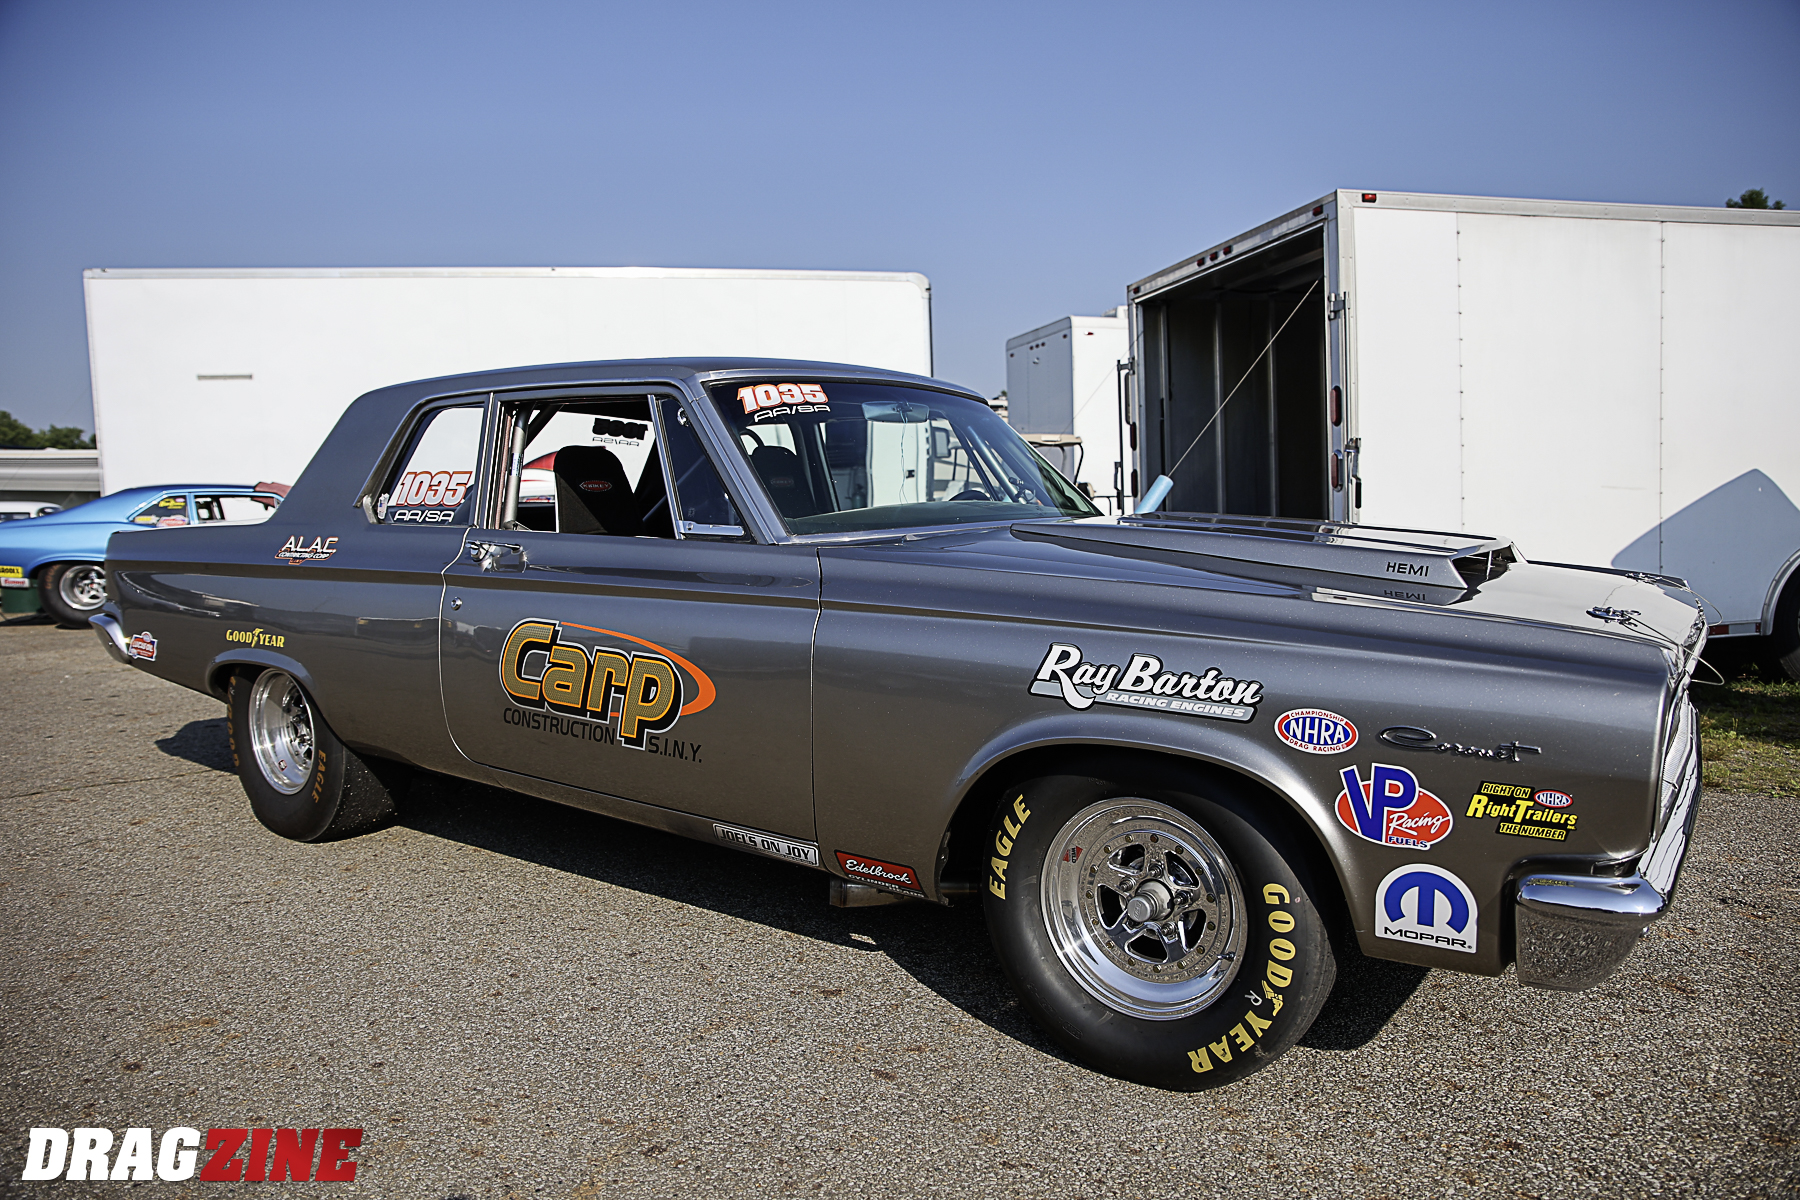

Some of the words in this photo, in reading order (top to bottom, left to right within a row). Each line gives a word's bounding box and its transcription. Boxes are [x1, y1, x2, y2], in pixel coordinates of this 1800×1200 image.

[737, 383, 829, 414] 1035
[753, 404, 831, 423] AA/SA
[396, 470, 474, 508] 1035
[393, 509, 455, 523] AA/SA
[1386, 561, 1429, 577] HEMI
[225, 627, 285, 648] GOODYEAR
[500, 618, 684, 750] Carp
[1035, 643, 1121, 710] Ray
[1117, 655, 1264, 704] Barton
[1105, 692, 1167, 709] RACING
[1168, 700, 1246, 718] ENGINES
[1290, 710, 1345, 722] CHAMPIONSHIP
[503, 707, 616, 746] CONSTRUCTION
[648, 735, 703, 764] S.I.N.Y.
[1289, 717, 1346, 745] NHRA
[1289, 738, 1309, 750] DRAG
[1312, 744, 1341, 752] RACING
[311, 749, 326, 803] EAGLE
[1481, 782, 1514, 797] RIGHT
[1513, 787, 1531, 799] ON
[1539, 792, 1568, 806] NHRA
[1339, 763, 1419, 843] VP
[1388, 812, 1450, 836] Racing
[1500, 823, 1521, 835] THE
[1519, 825, 1567, 841] NUMBER
[760, 838, 781, 853] ON
[785, 844, 810, 860] JOY
[989, 794, 1031, 900] EAGLE
[1388, 835, 1428, 848] FUELS
[845, 859, 912, 884] Edelbrock
[1384, 926, 1467, 949] MOPAR
[1187, 883, 1296, 1073] GOODYEAR
